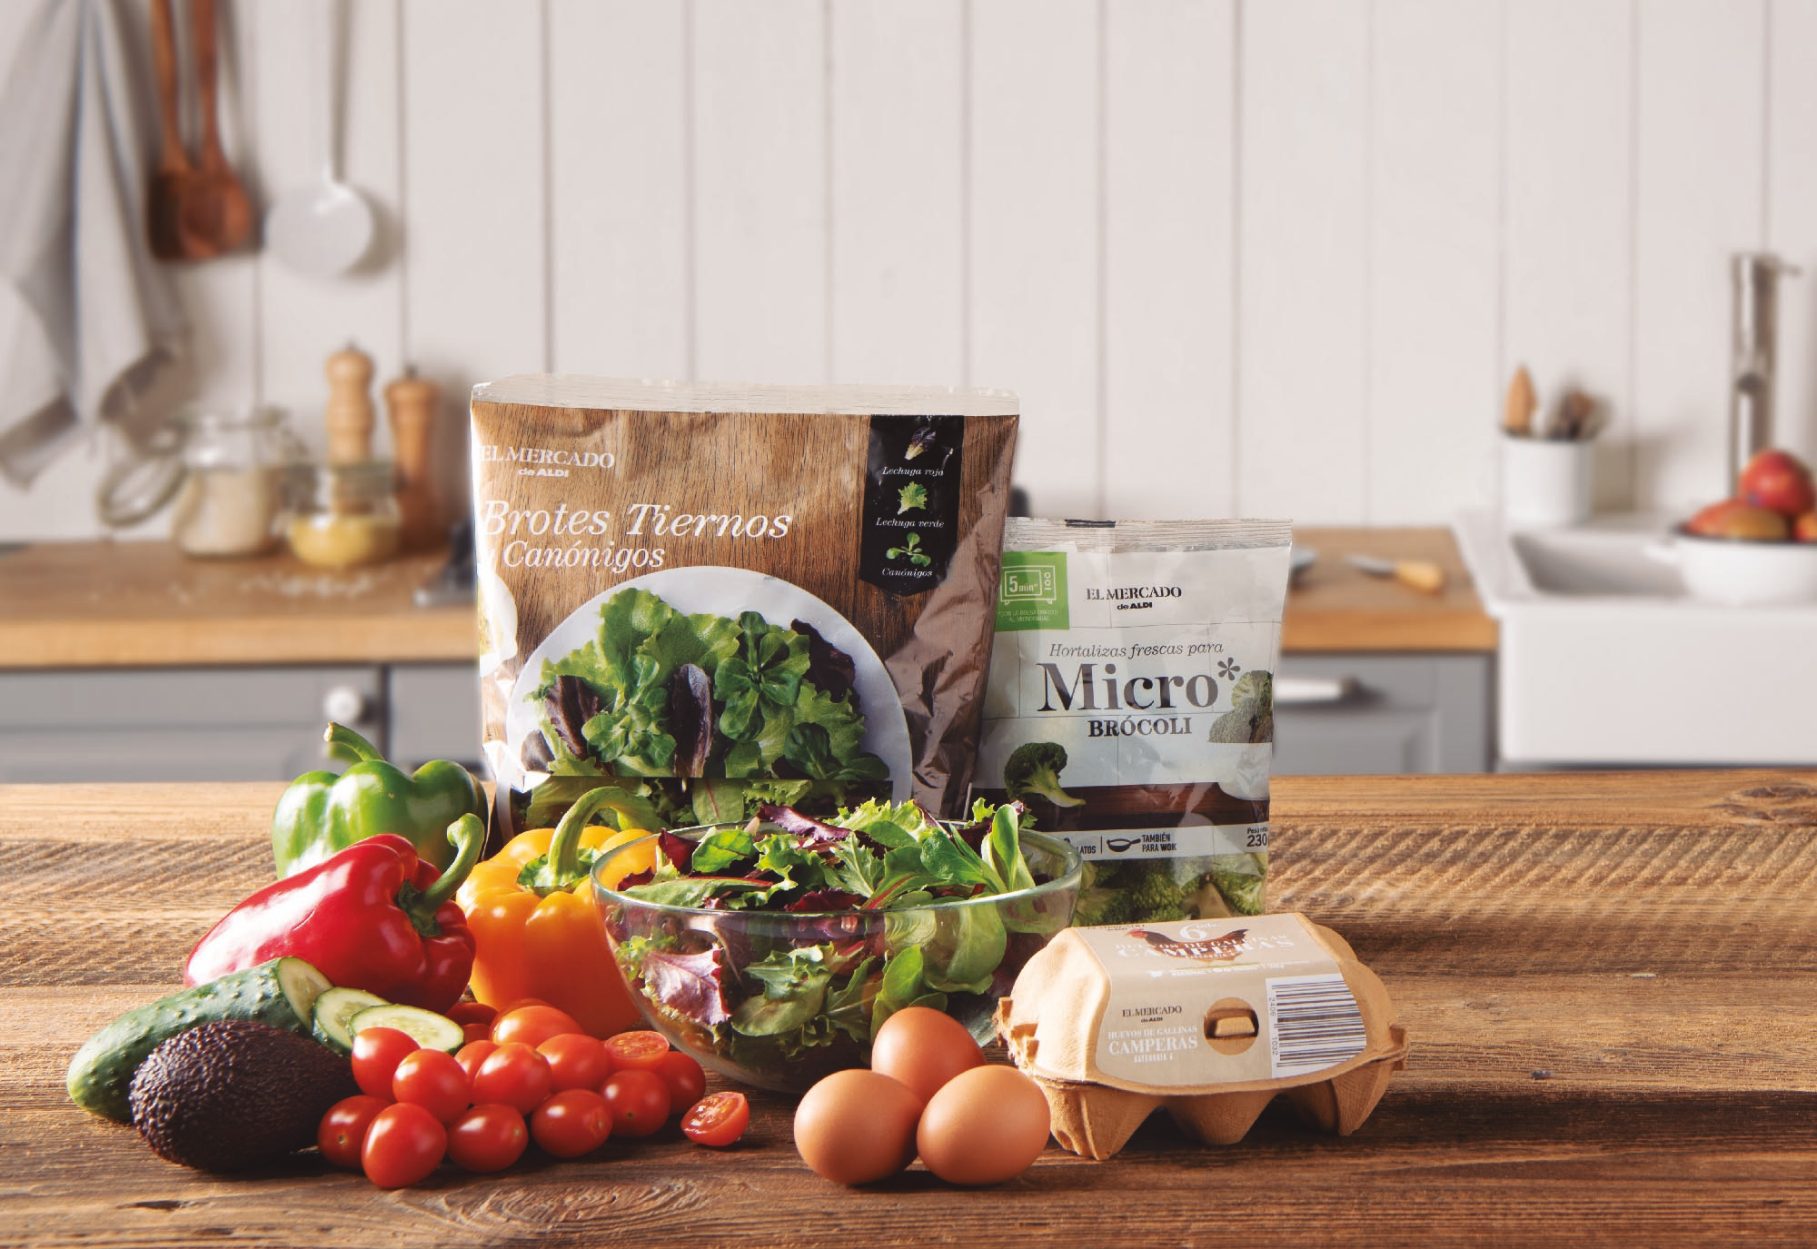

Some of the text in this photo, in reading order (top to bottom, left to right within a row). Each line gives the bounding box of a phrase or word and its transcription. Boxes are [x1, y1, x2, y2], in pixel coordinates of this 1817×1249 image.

[480, 444, 616, 469] EL MERCADO
[519, 467, 570, 477] de ALDI
[882, 466, 944, 477] Lechuga roja
[483, 499, 793, 538] Brotes Tiernos
[875, 517, 944, 529] Lechuga verde
[503, 540, 666, 573] Canónigos
[881, 567, 933, 579] Canónigos
[1086, 586, 1182, 600] EL MERCADO
[1130, 601, 1153, 610] ALDI
[1049, 643, 1224, 659] Hortalizas frescas para
[1087, 715, 1193, 738] BRÓCOLI
[1142, 832, 1171, 843] TAMBIÉN
[1076, 845, 1096, 855] LATOS
[1142, 843, 1177, 852] PARA WOK
[1179, 923, 1207, 939] 6
[1134, 1005, 1182, 1017] MERCADO
[1107, 1035, 1199, 1056] CAMPERAS
